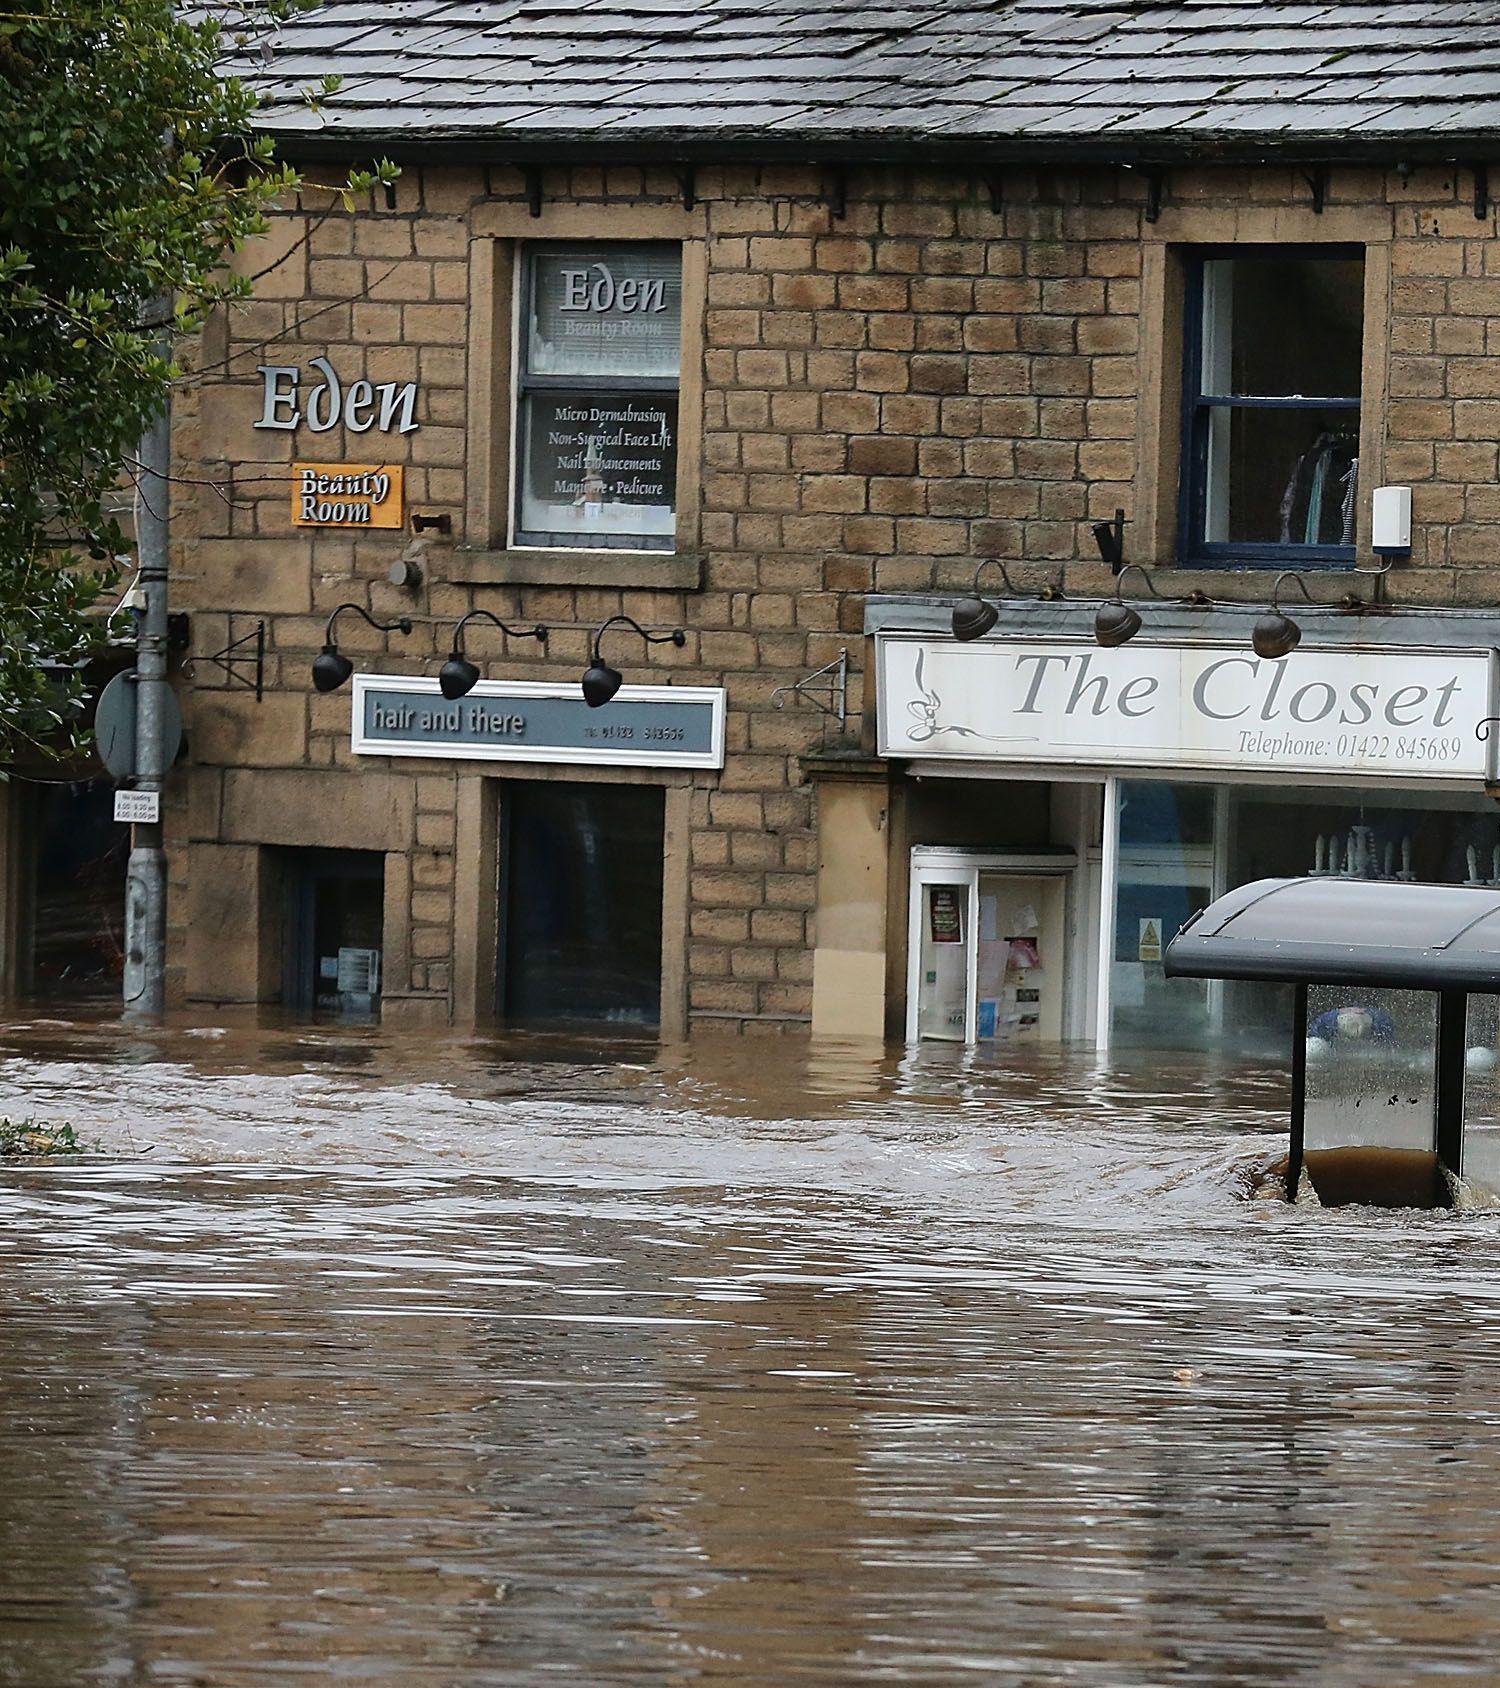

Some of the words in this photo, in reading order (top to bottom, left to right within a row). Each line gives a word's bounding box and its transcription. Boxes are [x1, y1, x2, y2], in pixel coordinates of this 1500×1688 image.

[559, 263, 668, 313] Eden
[253, 355, 420, 434] Eden
[555, 406, 588, 422] Micro
[589, 404, 666, 423] Dermabrasion
[548, 427, 622, 450] Non-Surgical
[624, 433, 649, 447] Face
[651, 428, 672, 450] Lift
[557, 451, 583, 470] Nail
[300, 469, 388, 504] Beauty
[616, 476, 663, 495] Pedicure
[300, 496, 370, 523] Room
[1014, 653, 1158, 718] The
[1192, 657, 1462, 728] Closet
[373, 702, 415, 729] hair
[420, 704, 460, 732] and
[467, 705, 525, 735] there
[1238, 731, 1332, 757] Telephone:
[1336, 735, 1390, 759] 01422
[1395, 736, 1461, 762] 845689
